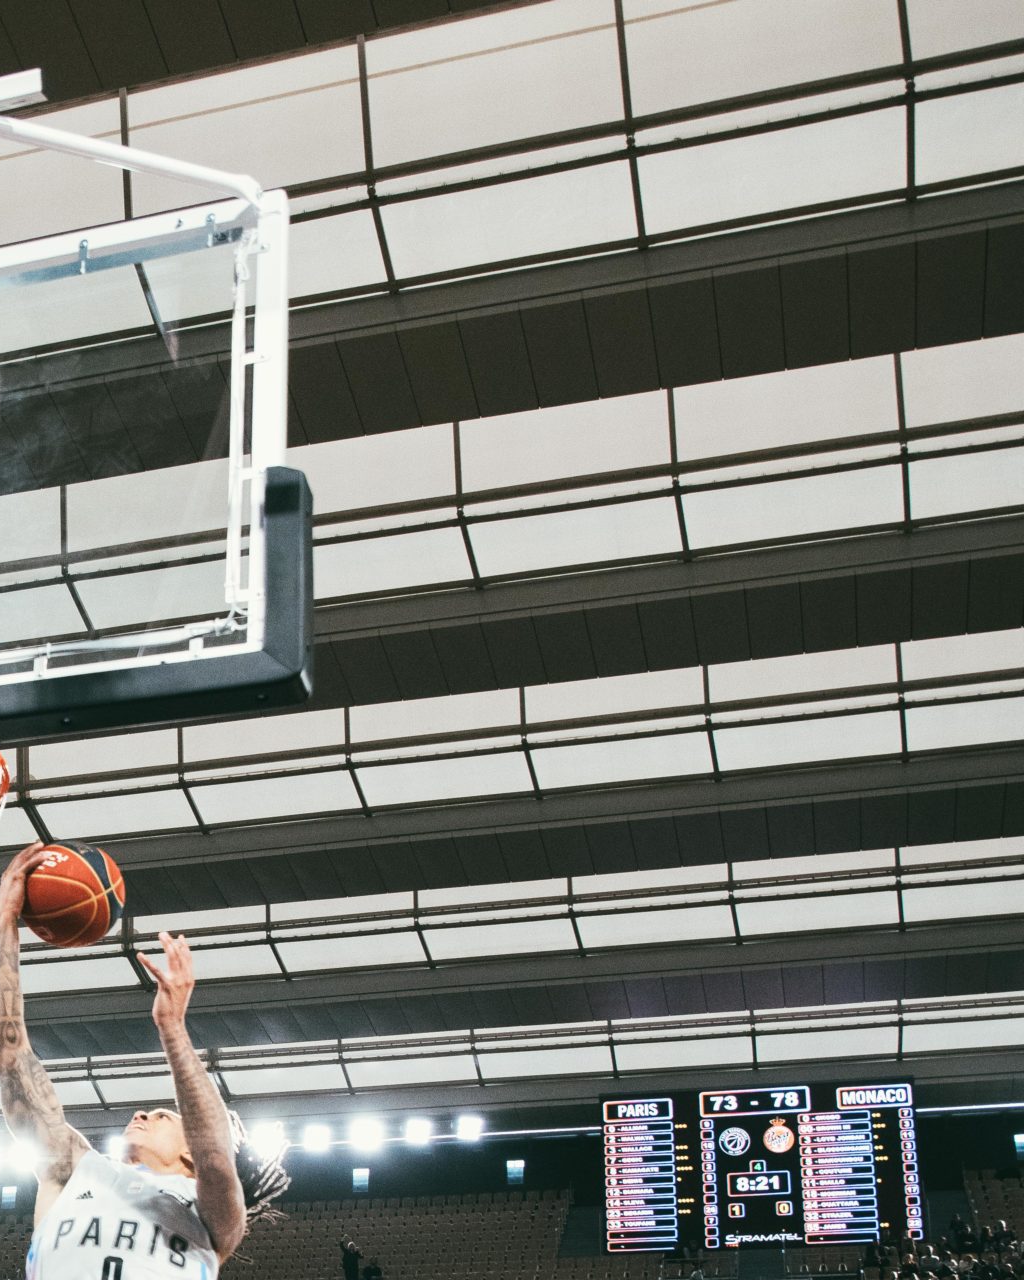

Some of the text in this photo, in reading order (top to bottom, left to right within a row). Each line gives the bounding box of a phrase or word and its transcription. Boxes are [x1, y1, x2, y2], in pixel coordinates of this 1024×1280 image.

[709, 1095, 738, 1111] 73
[771, 1091, 799, 1107] 78
[842, 1088, 906, 1105] MONACO
[617, 1103, 658, 1118] PARIS
[736, 1176, 780, 1192] 8:21
[805, 1179, 816, 1187] 11
[732, 1205, 740, 1215] 1
[778, 1203, 789, 1214] 0
[53, 1217, 190, 1269] PARIS
[725, 1232, 803, 1245] STRAMATEL
